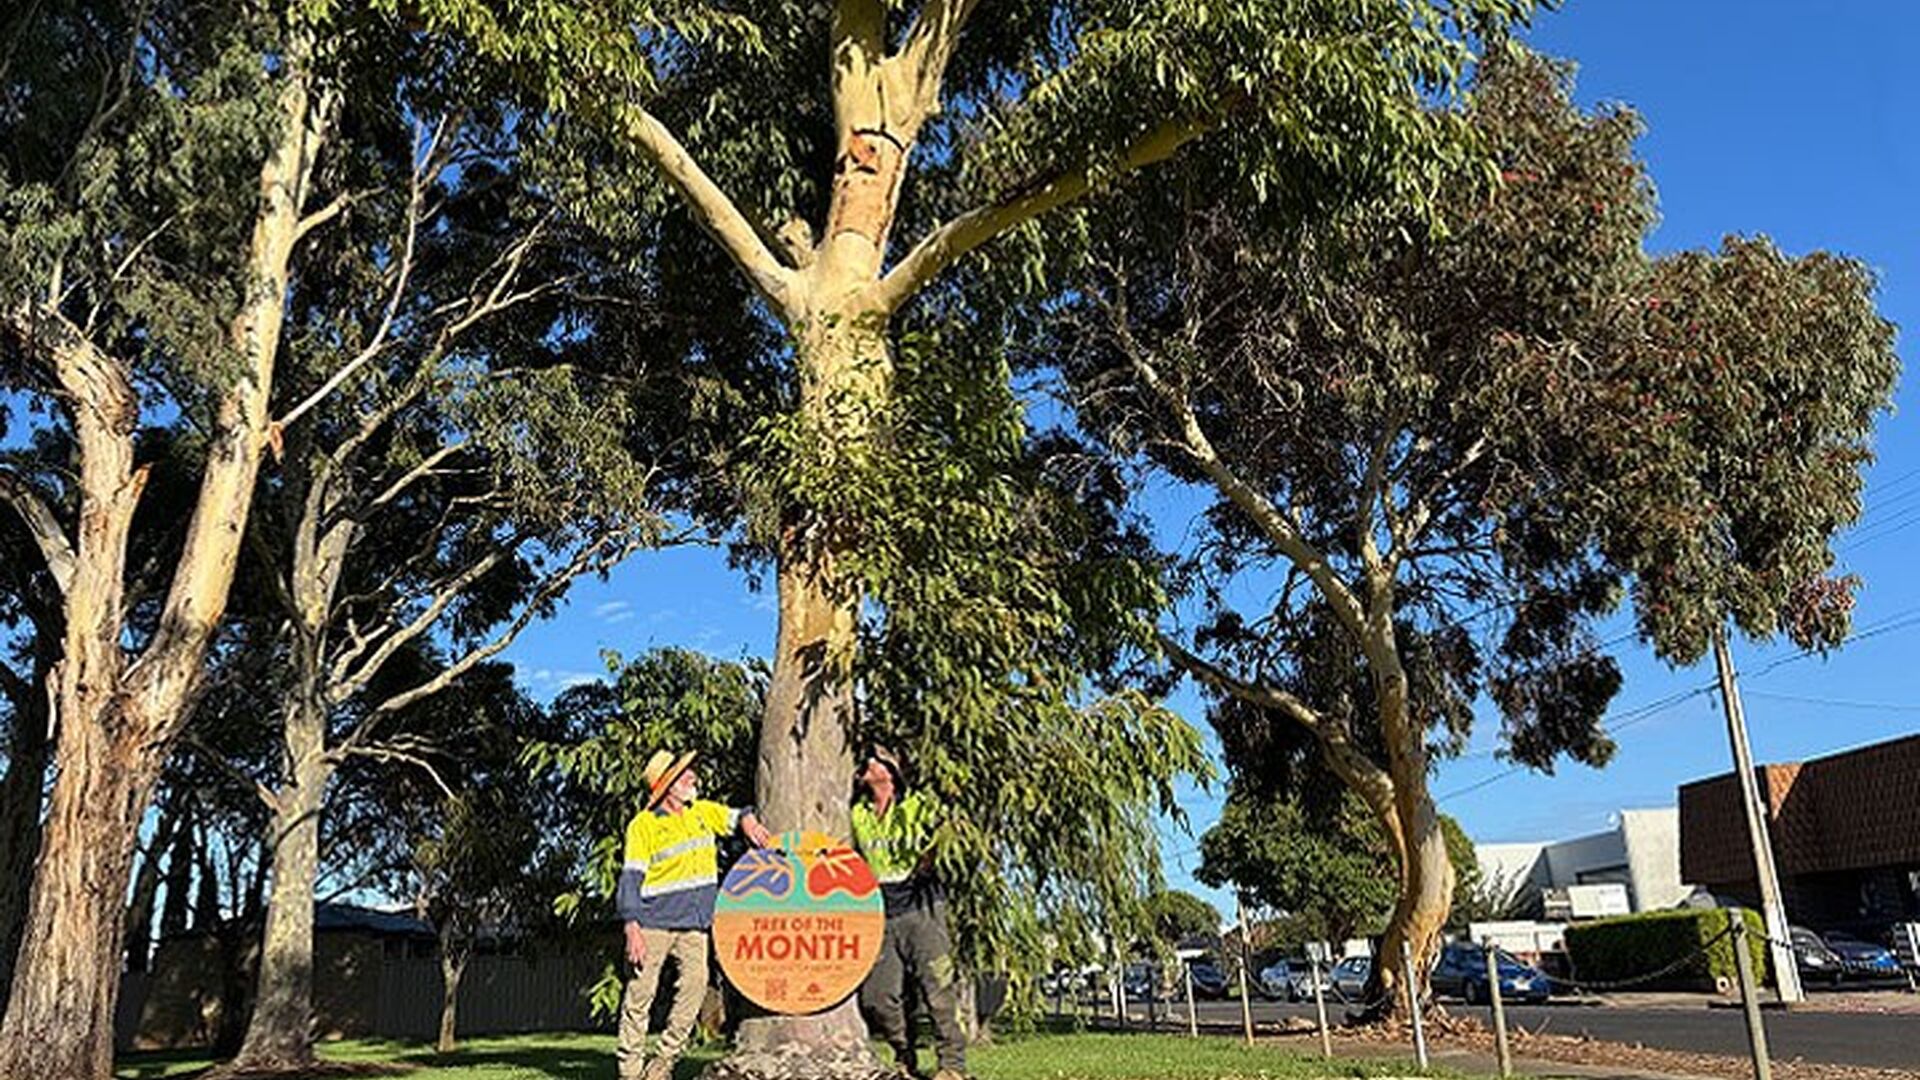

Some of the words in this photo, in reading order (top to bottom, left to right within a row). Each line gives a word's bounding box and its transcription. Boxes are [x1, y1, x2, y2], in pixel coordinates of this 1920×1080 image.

[752, 918, 787, 932] TREE
[791, 918, 812, 932] OF
[817, 918, 844, 932] THE
[735, 934, 860, 960] MONTH
